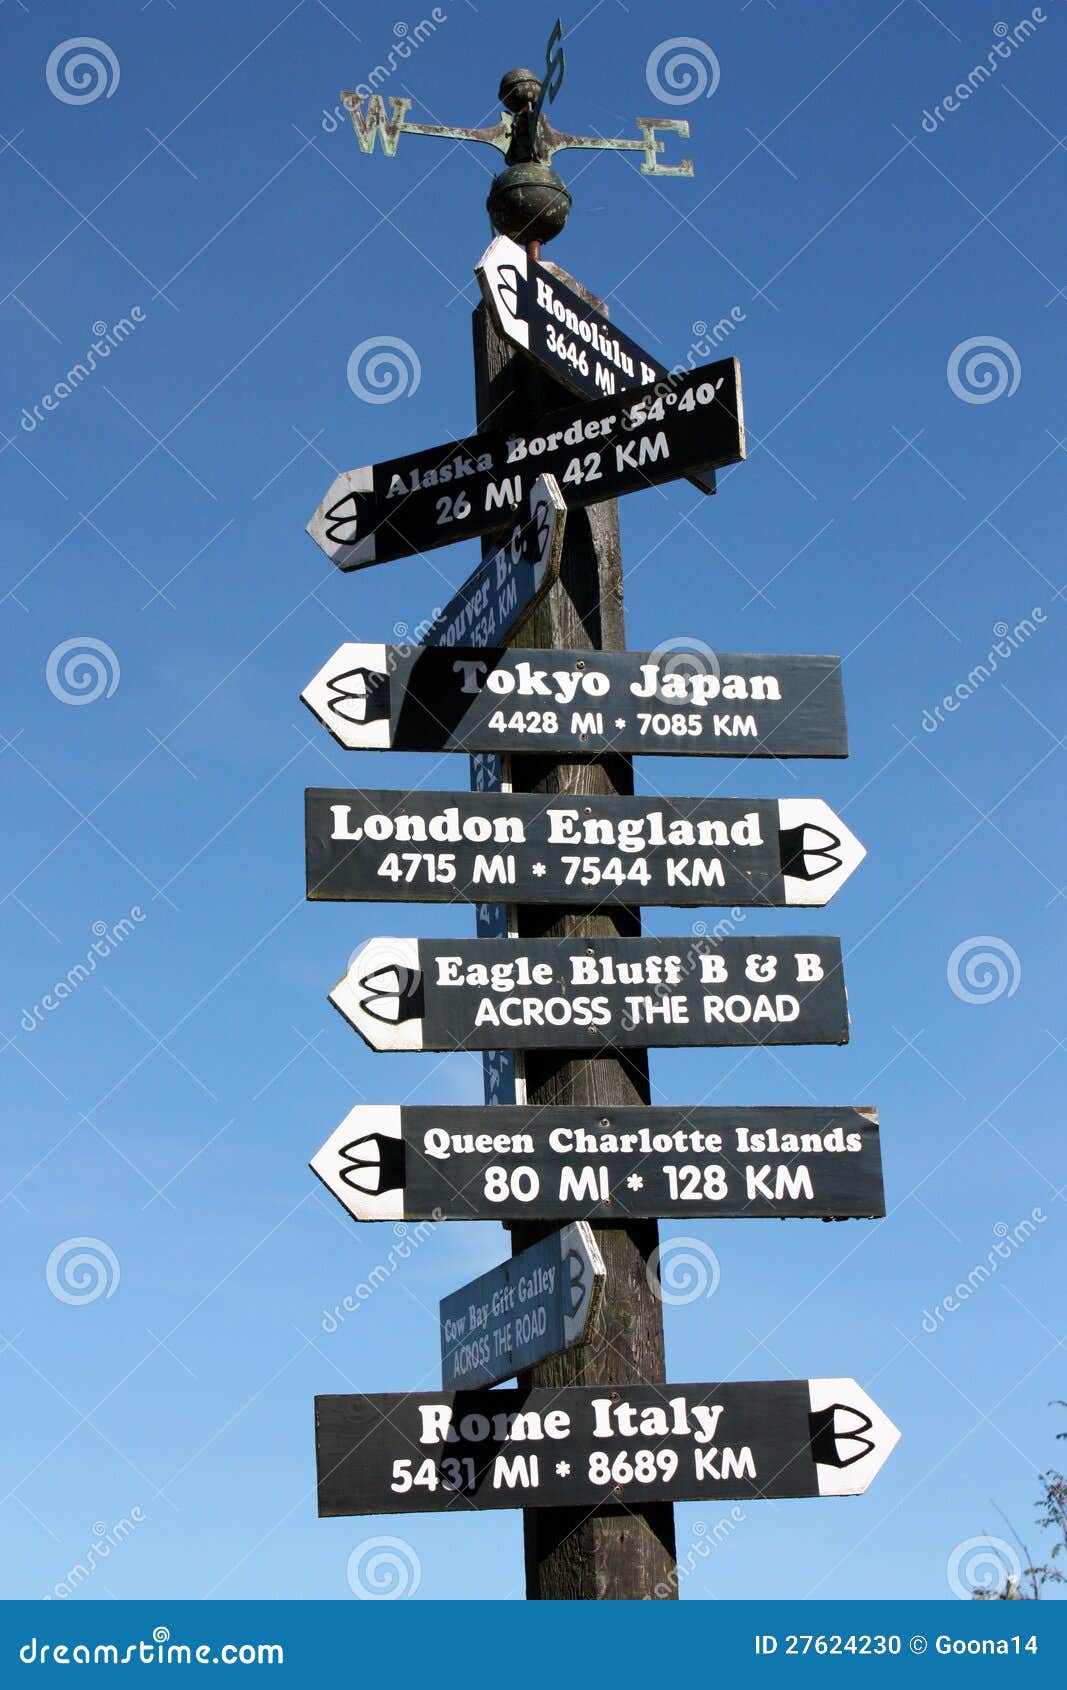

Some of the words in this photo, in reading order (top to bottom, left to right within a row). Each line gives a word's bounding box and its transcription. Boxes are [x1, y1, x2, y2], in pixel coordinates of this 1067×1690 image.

[340, 90, 412, 157] W
[636, 117, 695, 178] E
[536, 277, 635, 378] Honolulu
[546, 324, 589, 377] 3646
[595, 362, 615, 395] MI
[385, 453, 494, 499] Alaska
[506, 415, 617, 464] Border
[436, 491, 471, 525] 26
[485, 475, 522, 512] MI
[562, 451, 603, 486] 42
[616, 431, 670, 473] KM
[495, 524, 528, 591] B.C.
[499, 577, 518, 625] KM
[452, 660, 611, 704] Tokyo
[629, 664, 783, 706] Japan
[488, 711, 559, 734] 4428
[570, 713, 603, 735] MI
[636, 713, 703, 736] 7085
[713, 714, 758, 737] KM
[330, 804, 527, 843] London
[547, 809, 764, 854] England
[377, 853, 457, 884] 4715
[472, 854, 516, 885] MI
[560, 856, 651, 886] 7544
[666, 857, 726, 888] KM
[435, 956, 553, 991] Eagle
[569, 955, 682, 986] Bluff
[699, 954, 729, 983] B
[744, 953, 777, 983] &
[794, 953, 825, 983] B
[474, 997, 612, 1026] ACROSS
[624, 995, 690, 1025] THE
[703, 993, 801, 1024] ROAD
[423, 1127, 535, 1160] Queen
[548, 1127, 723, 1154] Charlotte
[736, 1127, 863, 1153] Islands
[484, 1165, 540, 1202] 80
[559, 1165, 610, 1201] MI
[662, 1165, 728, 1200] 128
[746, 1164, 815, 1200] KM
[444, 1315, 466, 1343] Cow
[468, 1303, 489, 1330] Bay
[492, 1286, 516, 1317] Gift
[518, 1266, 556, 1303] Galley
[454, 1335, 490, 1378] ACROSS
[493, 1322, 512, 1357] THE
[515, 1306, 547, 1347] ROAD
[418, 1404, 570, 1444] Rome
[591, 1397, 724, 1444] Italy
[390, 1456, 475, 1493] 5431
[492, 1454, 540, 1489] MI
[588, 1448, 679, 1486] 8689
[694, 1446, 757, 1482] KM
